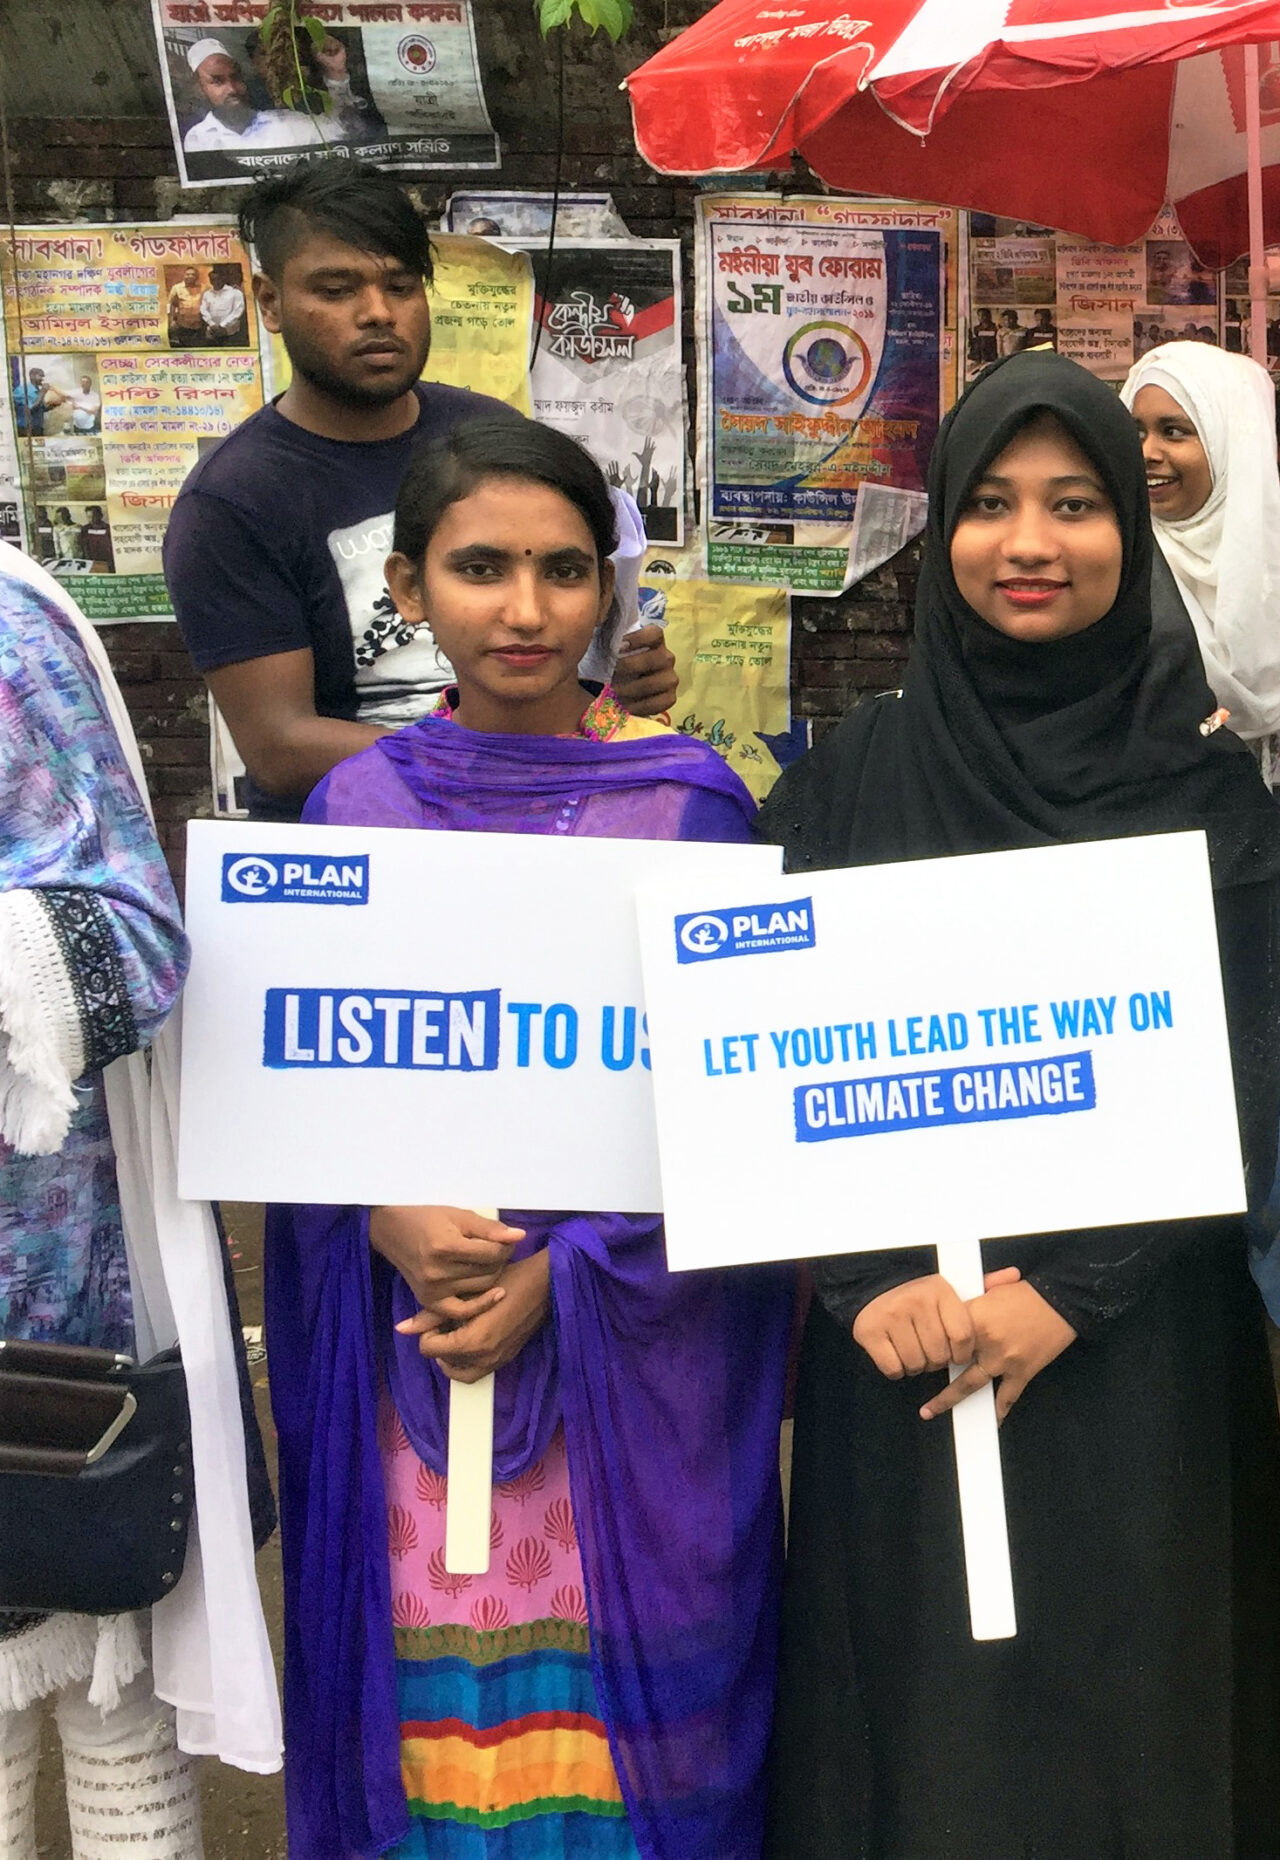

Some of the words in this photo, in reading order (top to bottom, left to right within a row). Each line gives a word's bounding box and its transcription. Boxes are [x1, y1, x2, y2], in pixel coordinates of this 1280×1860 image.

[7, 233, 104, 261] সাবধান!
[114, 231, 241, 259] “গডফাদার”
[785, 254, 813, 283] যুব
[819, 256, 884, 281] ফোরাম
[726, 281, 785, 315] ১ম
[1069, 295, 1136, 313] জিসান
[23, 316, 91, 332] আমিনুল
[100, 316, 159, 331] ইসলাম
[174, 386, 236, 401] রিপন
[121, 491, 178, 509] জিসা
[283, 863, 363, 887] PLAN
[284, 888, 363, 899] INTERNATIONAL
[733, 909, 809, 938] PLAN
[735, 934, 810, 950] INTERNATIONAL
[283, 993, 486, 1067] LISTEN
[507, 1002, 578, 1069] TO
[703, 1033, 760, 1077] LET
[769, 1021, 877, 1068] YOUTH
[888, 1012, 970, 1058] LEAD
[977, 1004, 1042, 1047] THE
[1049, 996, 1117, 1040] WAY
[1128, 990, 1174, 1032] ON
[803, 1075, 944, 1129] CLIMATE
[952, 1061, 1085, 1112] CHANGE
